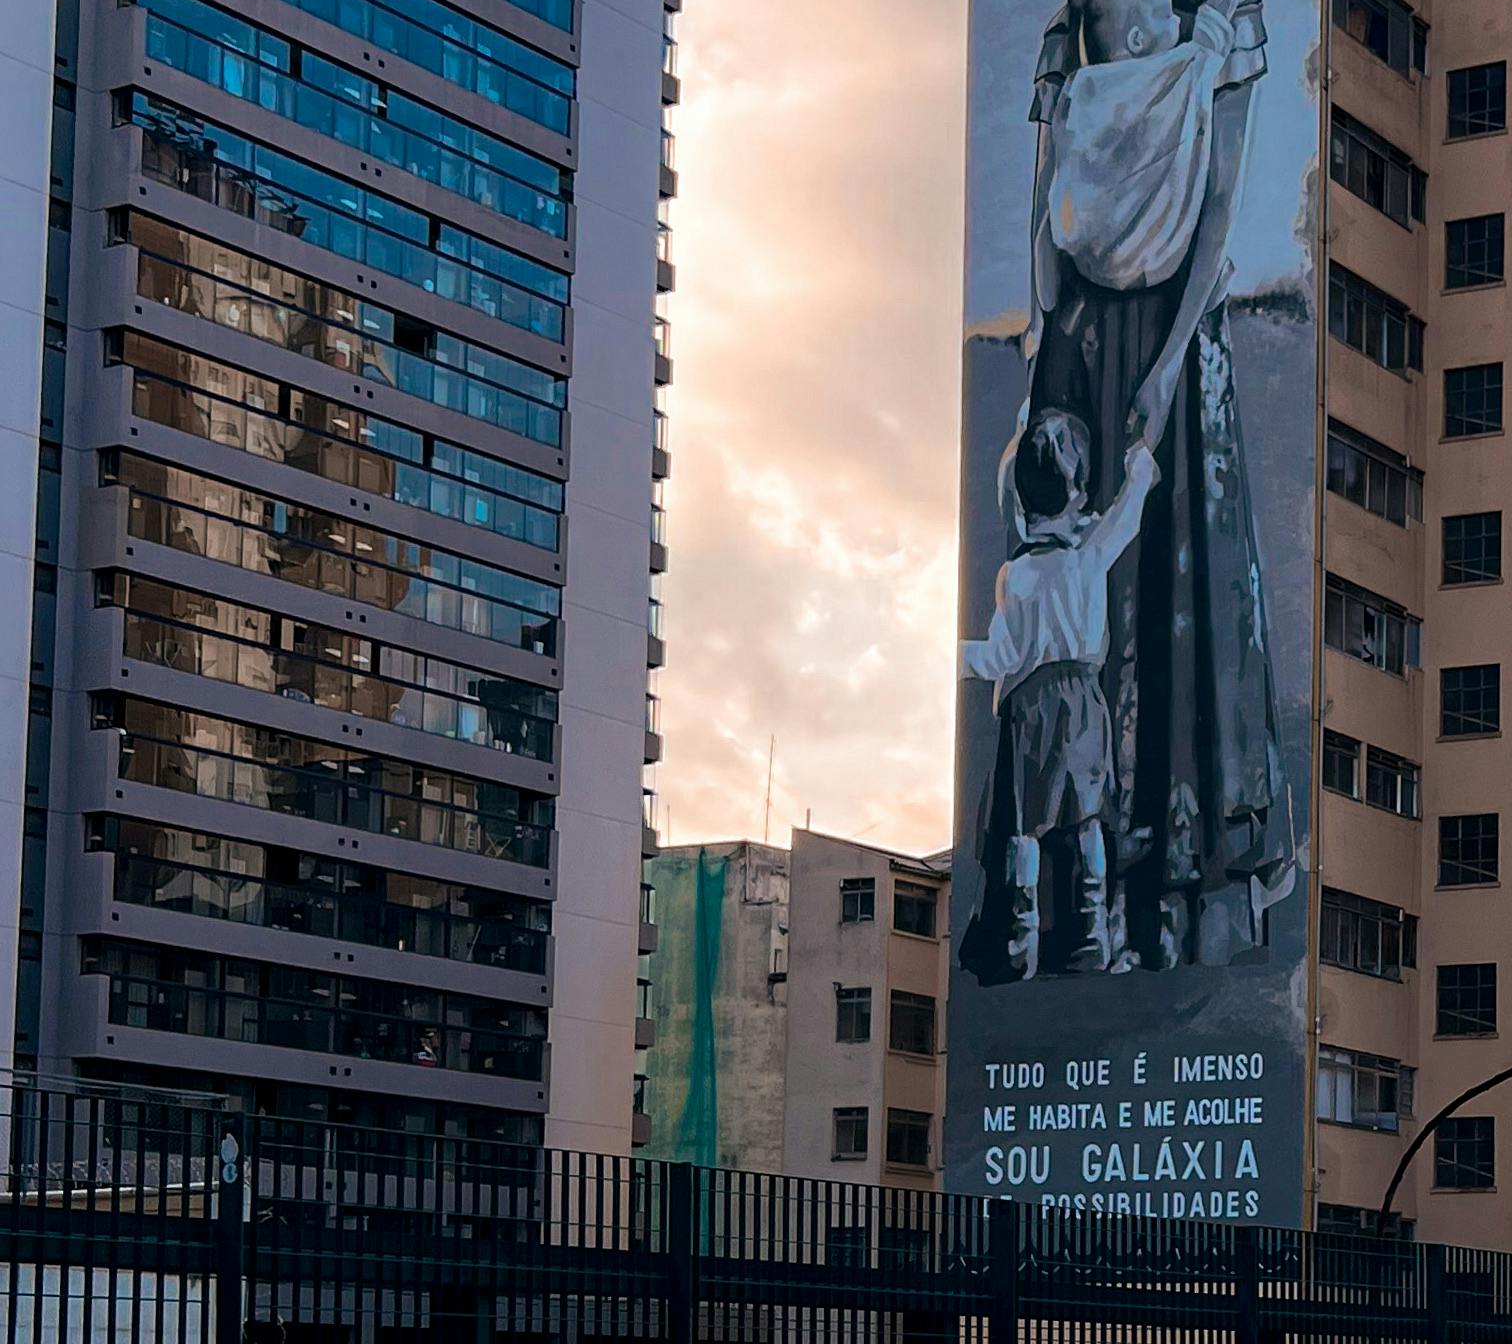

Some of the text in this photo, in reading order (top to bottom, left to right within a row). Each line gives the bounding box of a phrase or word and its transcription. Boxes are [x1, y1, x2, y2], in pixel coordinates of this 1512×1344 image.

[986, 1052, 1263, 1090] TUDO QUE É IMENSO
[984, 1098, 1263, 1131] ME HABITA E ME ACOLHE
[985, 1136, 1259, 1184] SOU GALÁXIA
